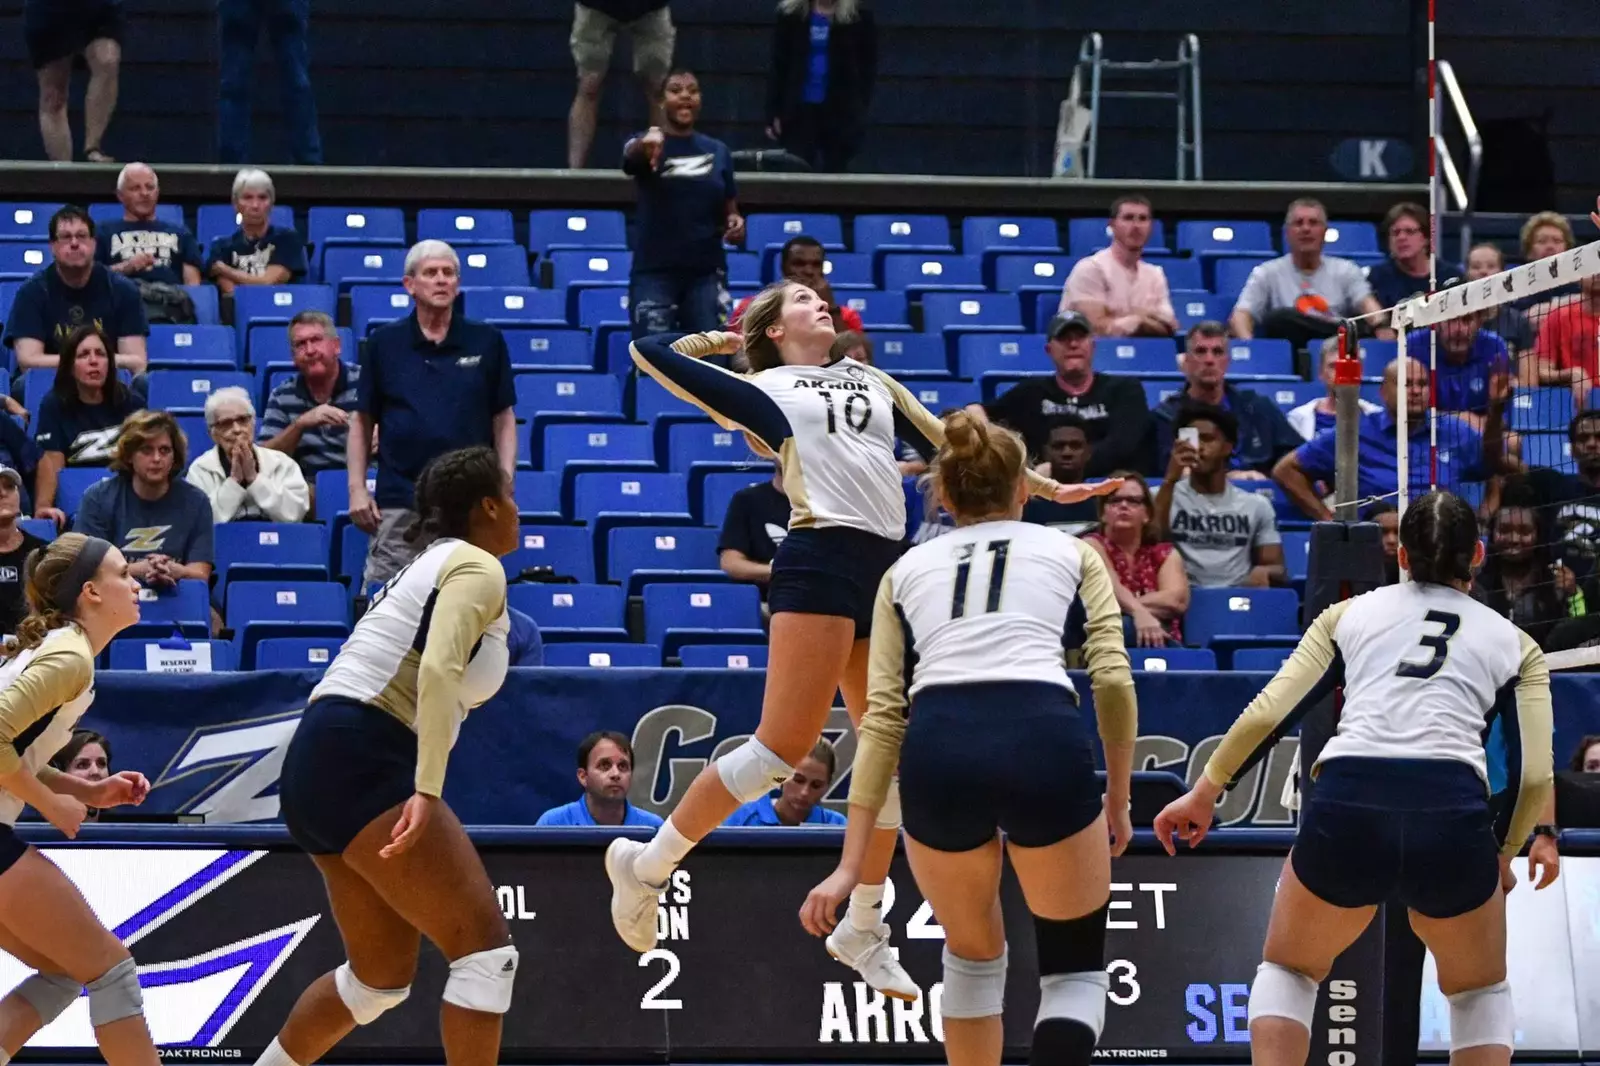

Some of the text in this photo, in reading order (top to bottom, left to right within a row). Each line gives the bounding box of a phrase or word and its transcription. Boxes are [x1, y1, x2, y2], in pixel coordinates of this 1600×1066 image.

[1359, 140, 1389, 177] K
[793, 379, 870, 392] AKRON
[817, 391, 872, 434] 10
[1172, 509, 1250, 535] AKRON
[950, 538, 1013, 620] 11
[1395, 609, 1462, 680] 3
[637, 949, 683, 1009] 2
[1106, 959, 1141, 1006] 3
[157, 1049, 242, 1058] DAKTRONICS
[1092, 1049, 1168, 1058] AKTRONICS
